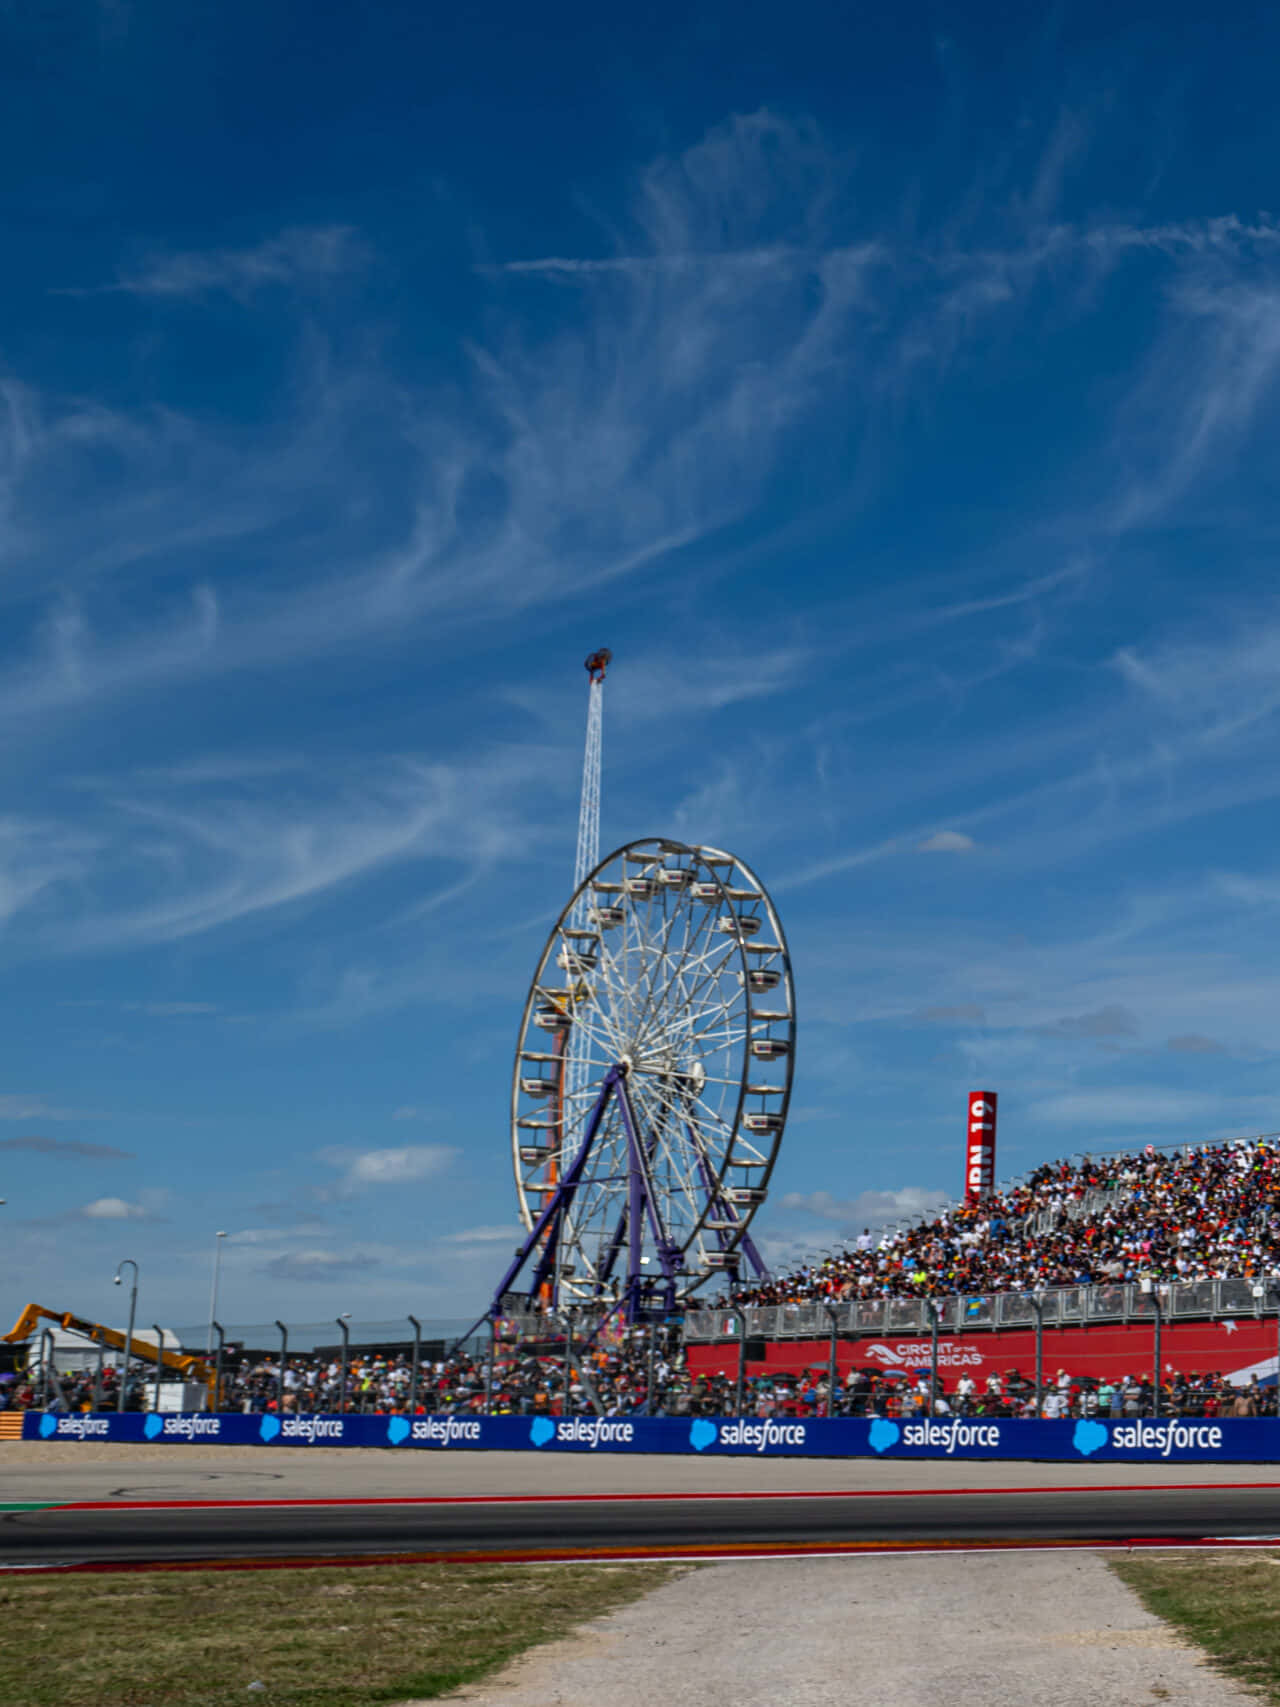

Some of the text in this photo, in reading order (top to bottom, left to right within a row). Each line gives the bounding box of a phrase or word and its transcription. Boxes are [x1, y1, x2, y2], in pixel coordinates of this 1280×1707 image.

[968, 1100, 994, 1197] RN 19
[896, 1342, 954, 1356] CIRCUIT
[904, 1353, 984, 1367] AMERICAS
[57, 1415, 109, 1439] salesforce
[163, 1414, 220, 1440] salesforce
[281, 1416, 343, 1442] salesforce
[411, 1416, 481, 1445] salesforce
[557, 1416, 633, 1448] salesforce
[720, 1418, 805, 1451] salesforce
[903, 1418, 1000, 1454] salesforce
[1112, 1418, 1222, 1456] salesforce
